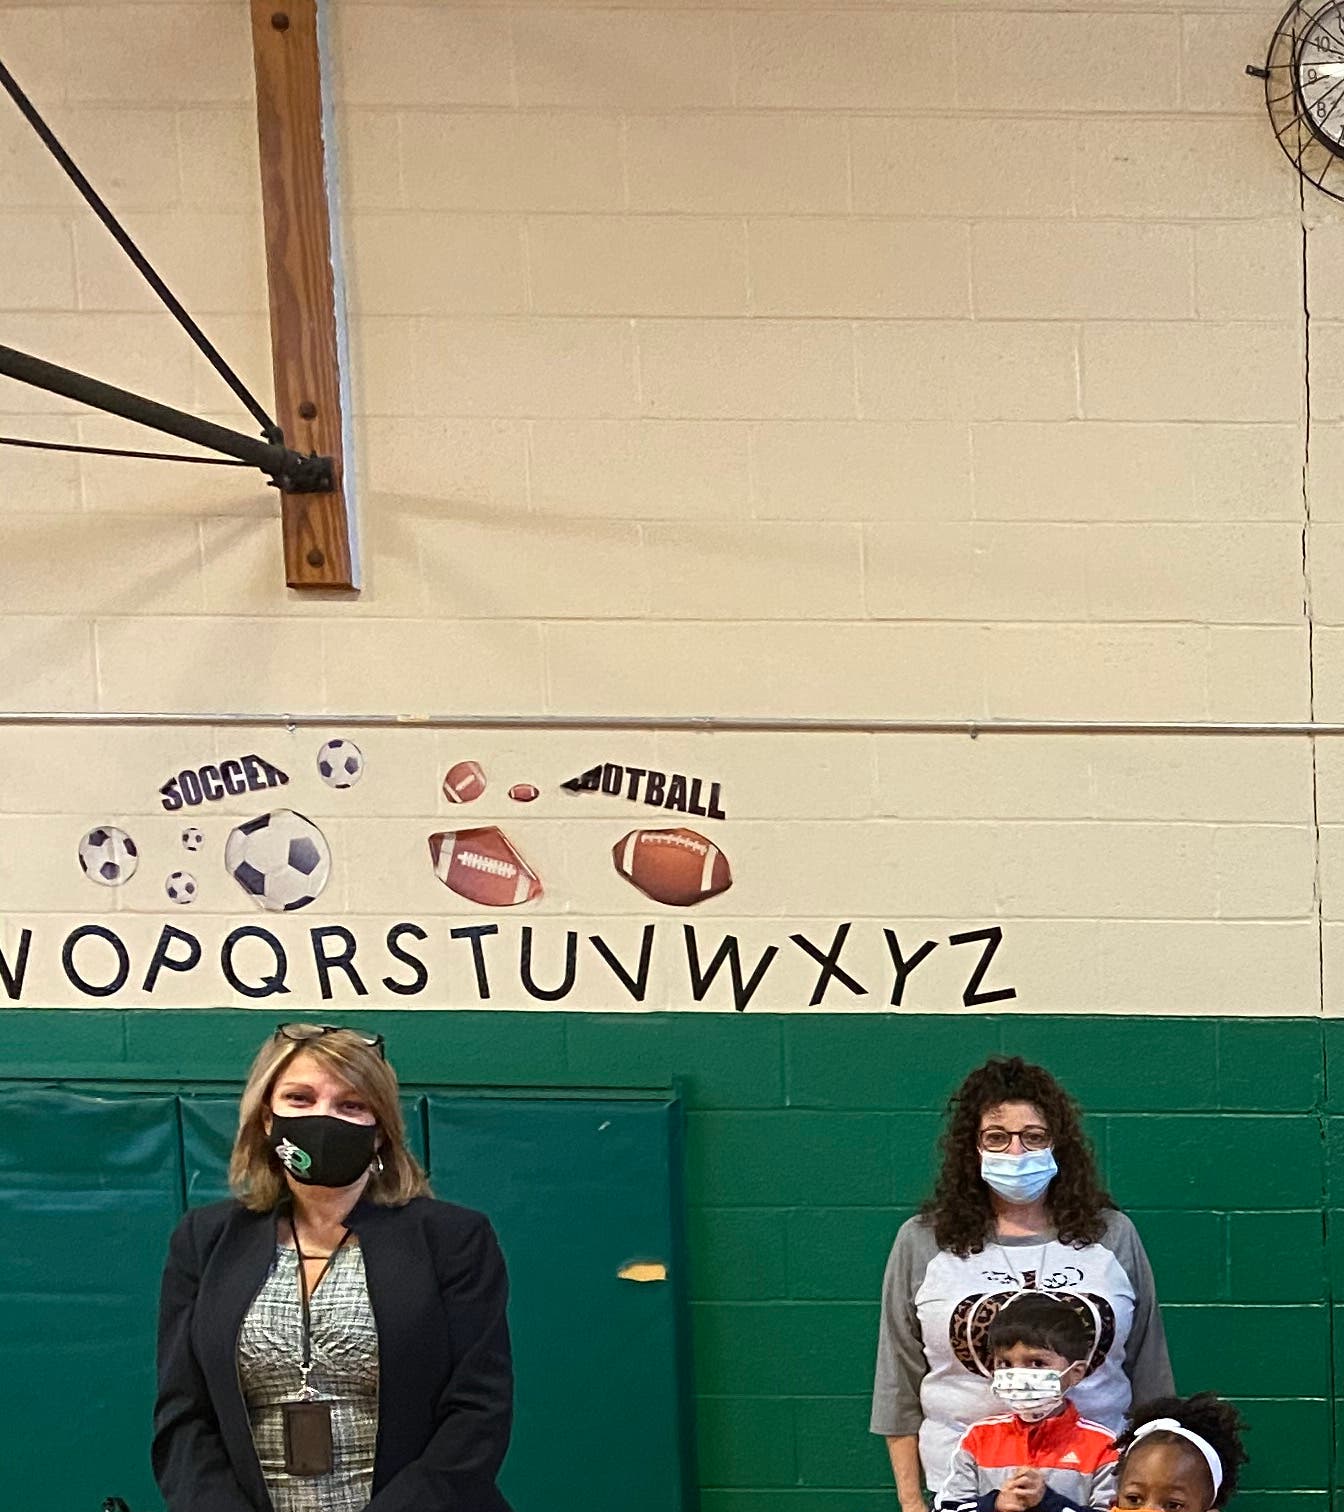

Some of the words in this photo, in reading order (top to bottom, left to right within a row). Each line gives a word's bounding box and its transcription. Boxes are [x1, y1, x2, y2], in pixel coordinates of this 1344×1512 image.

[1314, 36, 1330, 52] 10
[1308, 69, 1317, 84] 9
[1317, 102, 1326, 118] 8
